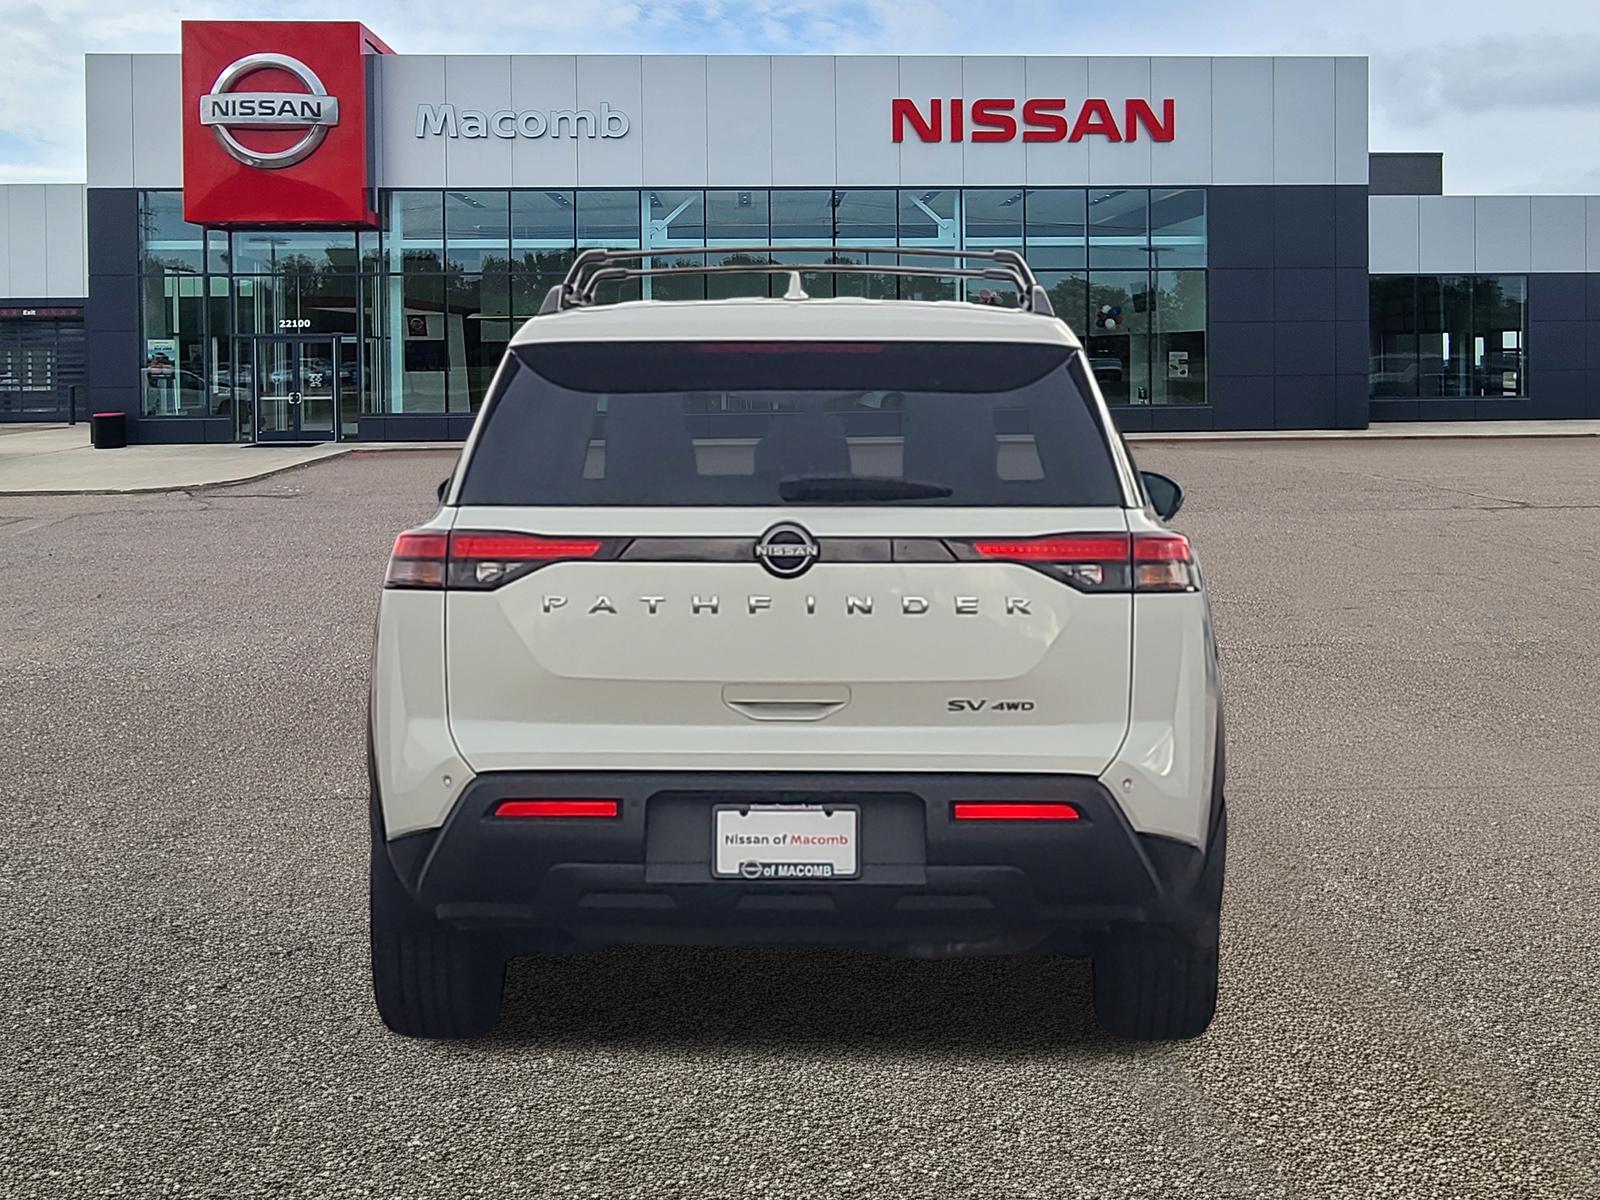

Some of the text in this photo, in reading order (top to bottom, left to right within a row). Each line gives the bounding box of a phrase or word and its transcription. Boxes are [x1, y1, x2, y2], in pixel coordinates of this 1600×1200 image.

[212, 100, 321, 117] NISSAN
[415, 102, 630, 138] Macomb
[892, 98, 1175, 143] NISSAN
[280, 319, 311, 328] 22100
[756, 545, 818, 556] NISSAN
[541, 594, 1033, 616] PATHFINDER
[947, 699, 1035, 711] SV 4WD
[725, 834, 848, 845] Nissan of Macomb
[763, 865, 776, 876] of
[778, 865, 832, 876] MACOMB
